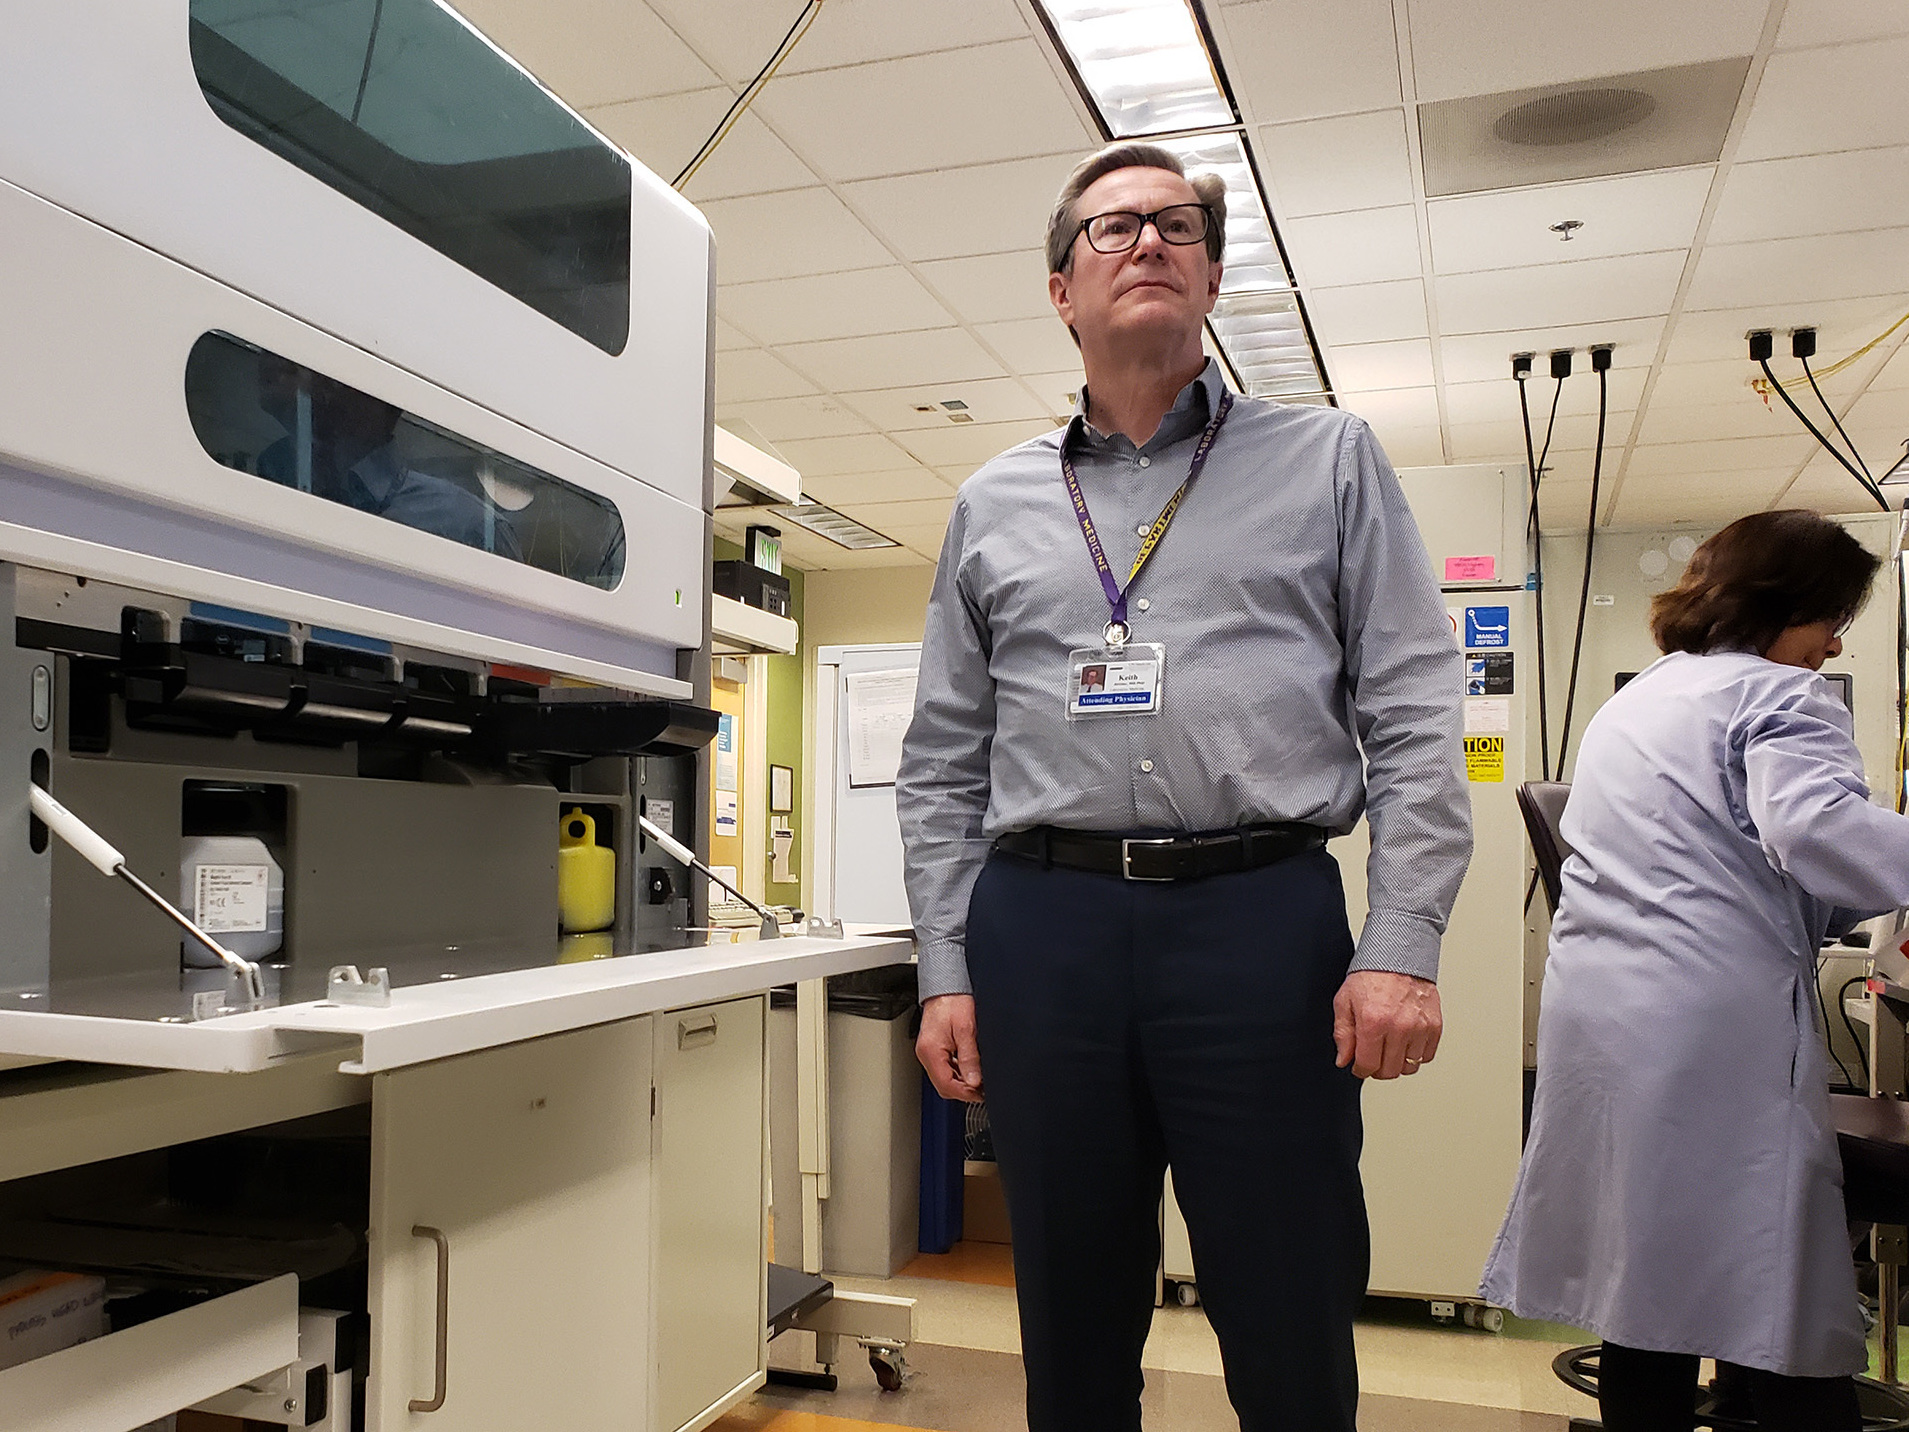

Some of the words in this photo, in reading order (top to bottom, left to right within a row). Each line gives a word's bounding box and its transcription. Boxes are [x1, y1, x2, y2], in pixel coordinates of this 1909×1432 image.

[1063, 459, 1086, 514] BORATORY
[1083, 518, 1109, 573] MEDICINE
[1081, 696, 1114, 704] Attending
[1463, 738, 1502, 752] TION
